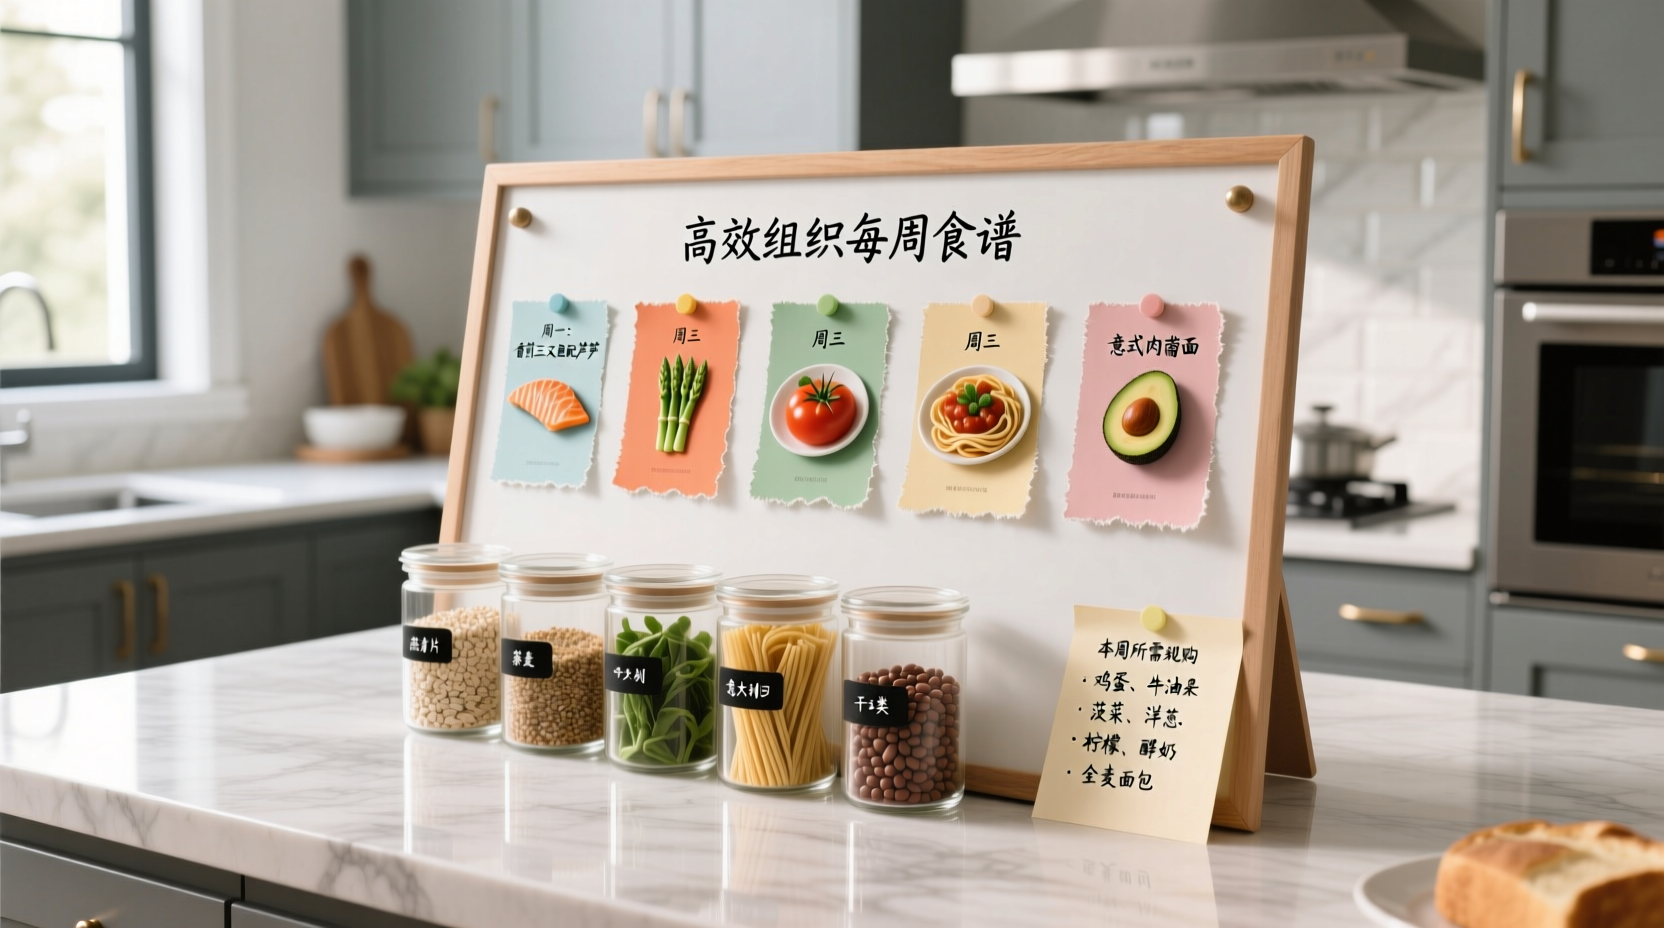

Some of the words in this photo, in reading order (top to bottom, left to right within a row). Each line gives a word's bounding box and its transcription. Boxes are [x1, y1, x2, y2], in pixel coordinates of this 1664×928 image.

[684, 209, 1022, 265] 高效组织每周食谱
[672, 327, 701, 344] 周三
[812, 329, 846, 350] 周三
[964, 331, 1001, 352] 周三
[1082, 764, 1153, 791] 全麦面包
